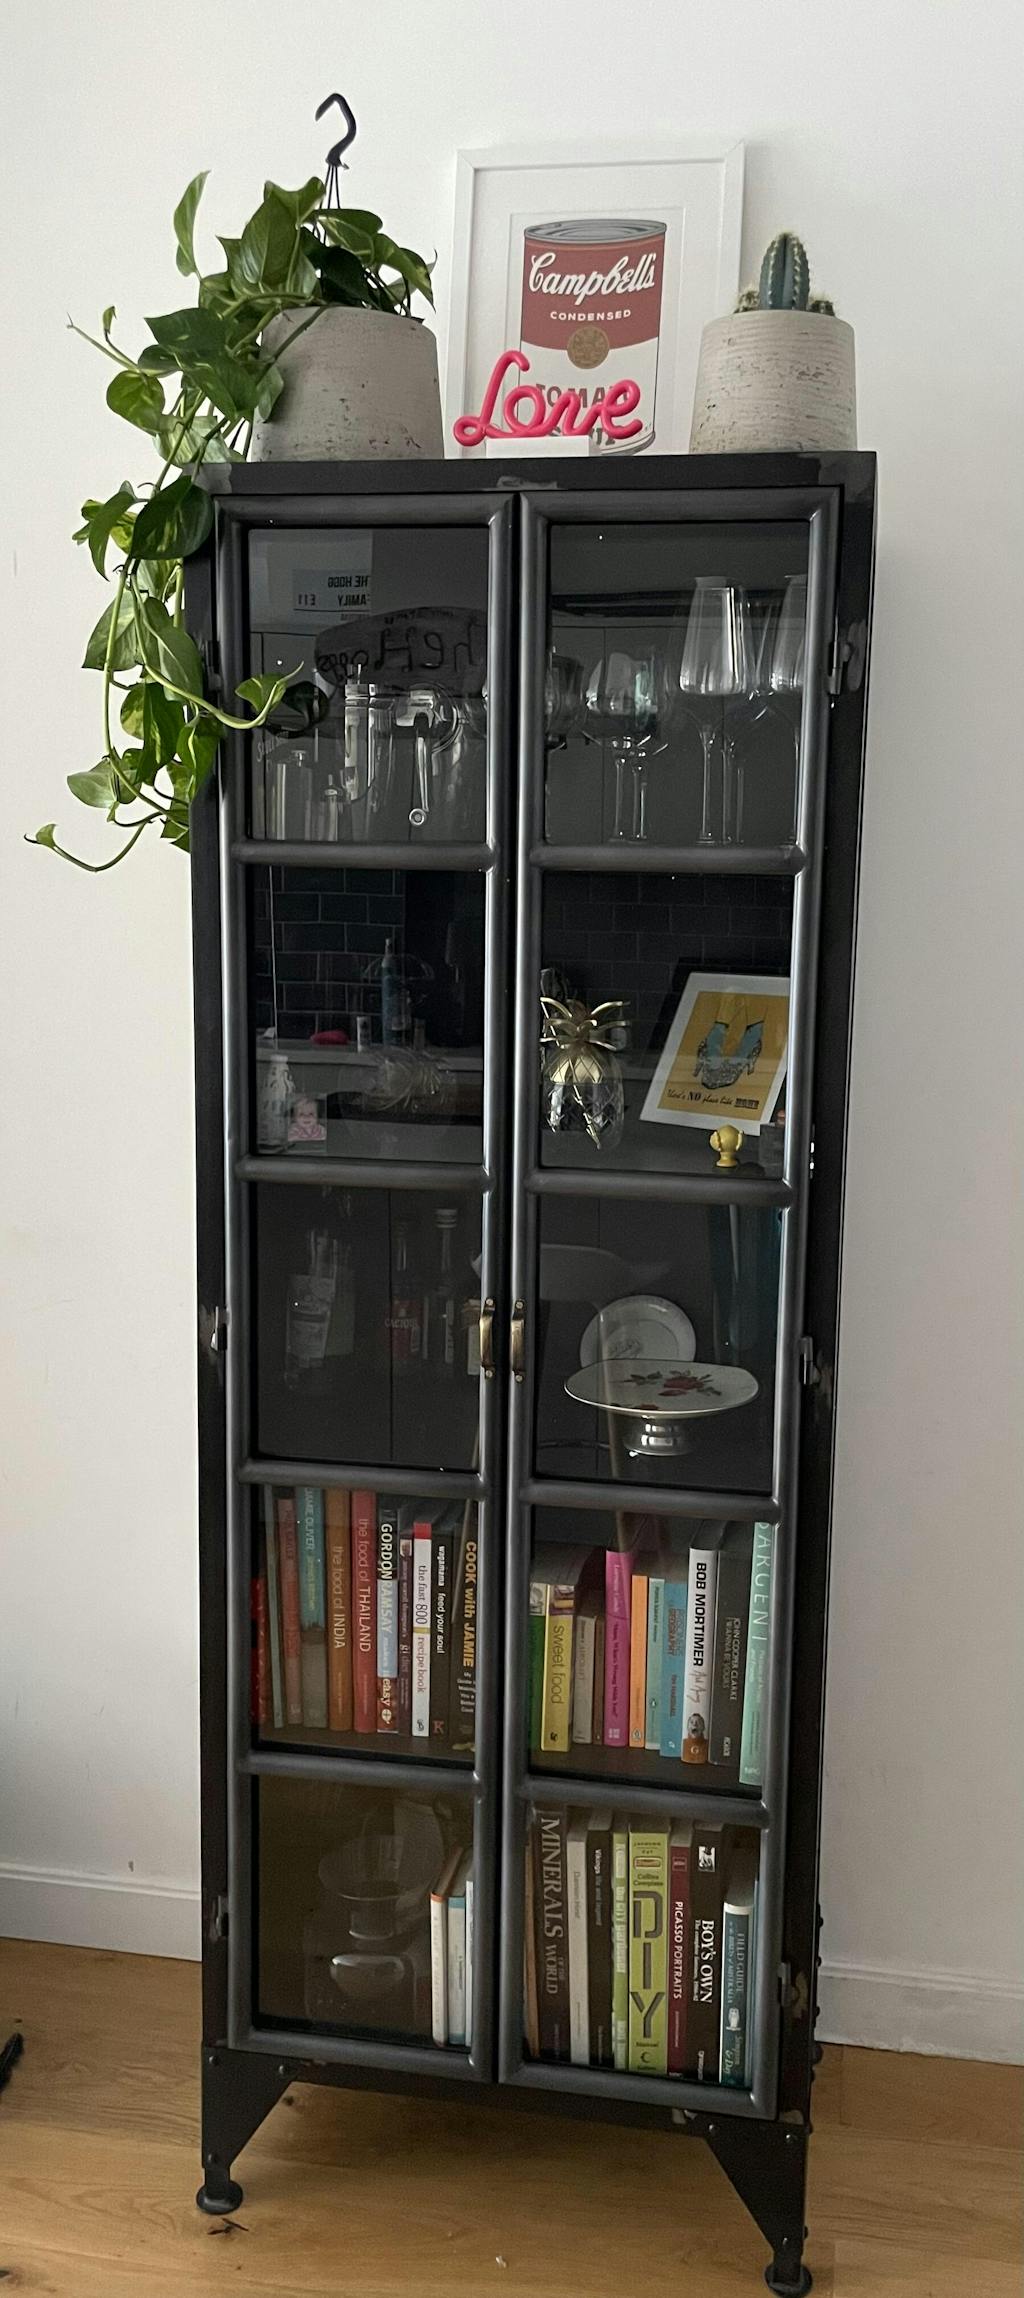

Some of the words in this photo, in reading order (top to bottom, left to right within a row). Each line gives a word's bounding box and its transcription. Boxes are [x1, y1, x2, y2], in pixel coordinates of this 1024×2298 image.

[528, 251, 656, 306] Campbell's
[550, 308, 632, 322] CONDENSED
[453, 349, 644, 447] Love
[687, 1091, 702, 1101] NO
[304, 1516, 315, 1551] OLIVER
[358, 1518, 370, 1536] the
[333, 1546, 344, 1565] the
[358, 1540, 370, 1567] food
[380, 1523, 393, 1580] GORDON
[437, 1545, 446, 1587] wagamama
[465, 1541, 477, 1584] COOK
[332, 1567, 344, 1594] food
[358, 1570, 370, 1582] of
[418, 1565, 427, 1581] the
[696, 1562, 707, 1589] BOB
[333, 1597, 344, 1609] of
[380, 1580, 393, 1634] RAMSAY
[418, 1583, 427, 1601] fast
[438, 1592, 446, 1612] feed
[464, 1587, 475, 1618] with
[358, 1586, 371, 1653] THAILAND
[415, 1603, 428, 1625] 800
[435, 1614, 445, 1634] your
[732, 1617, 740, 1638] JOHN
[333, 1612, 345, 1649] INDIA
[437, 1634, 446, 1654] soul
[463, 1622, 475, 1668] JAMIE
[692, 1593, 706, 1667] MORTIMER
[416, 1637, 427, 1668] recipe
[551, 1625, 566, 1668] sweet
[731, 1640, 740, 1669] COOPER
[380, 1678, 392, 1706] easy
[417, 1669, 427, 1694] book
[551, 1672, 566, 1704] food
[729, 1670, 739, 1701] CLARKE
[594, 1848, 602, 1874] Vikings
[541, 1817, 564, 1938] MINERALS
[615, 1902, 626, 1922] CITY
[674, 1901, 684, 1943] PICASSO
[700, 1919, 717, 1961] BOY'S
[736, 1932, 745, 1961] FIELD
[544, 1943, 559, 1994] WORLD
[630, 1890, 666, 2039] DIY
[673, 1945, 683, 1999] PORTRAITS
[735, 1963, 745, 1993] GUIDE
[699, 1964, 714, 2004] OWN
[726, 1964, 734, 2004] AUSTRALIA
